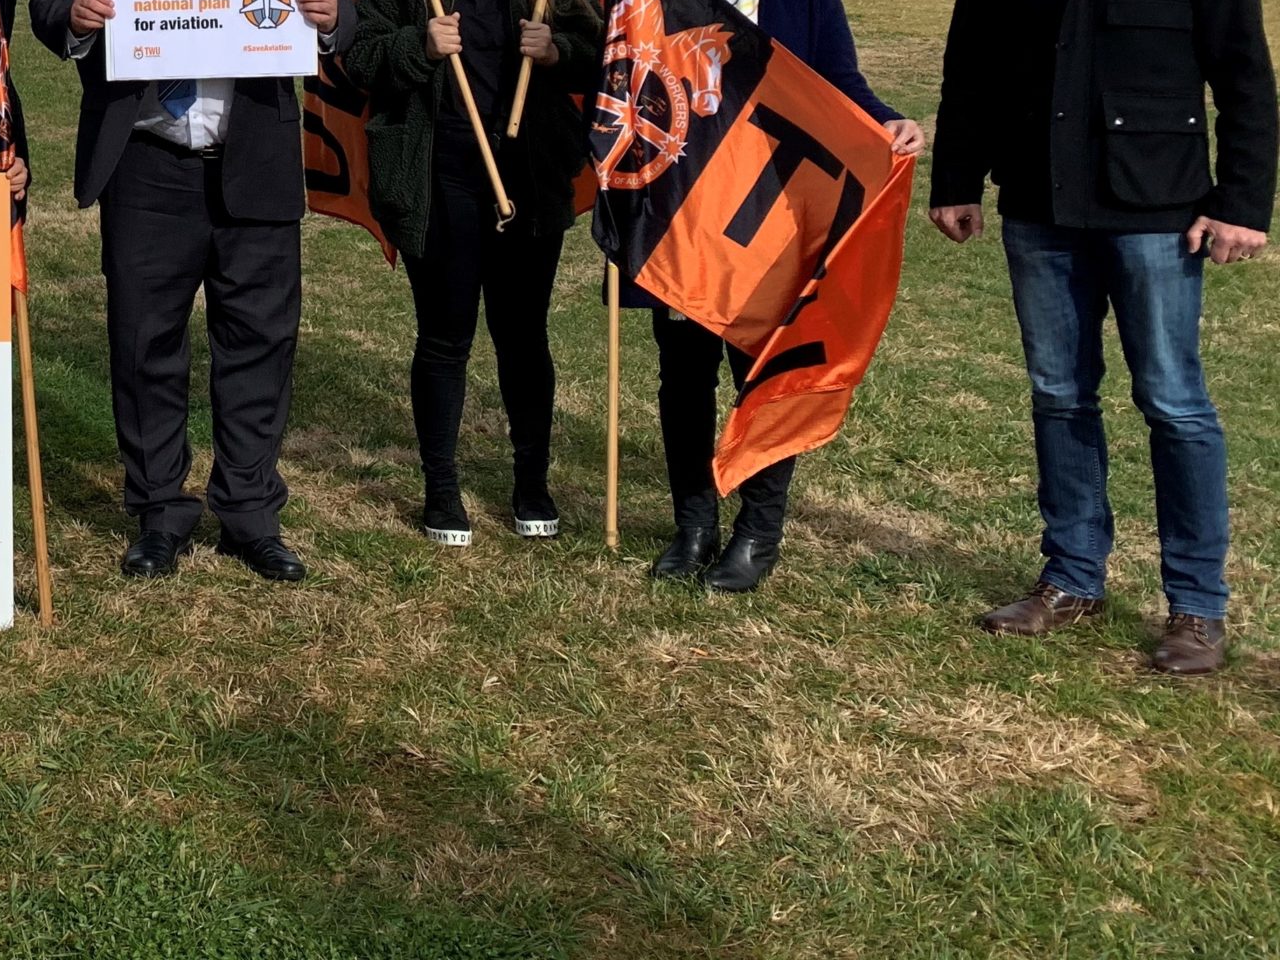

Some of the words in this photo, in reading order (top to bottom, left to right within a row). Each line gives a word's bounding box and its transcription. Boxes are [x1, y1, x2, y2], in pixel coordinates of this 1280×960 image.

[134, 18, 156, 31] for
[160, 16, 223, 30] aviation.
[144, 47, 161, 56] TWU
[243, 44, 293, 52] #SaveAviation
